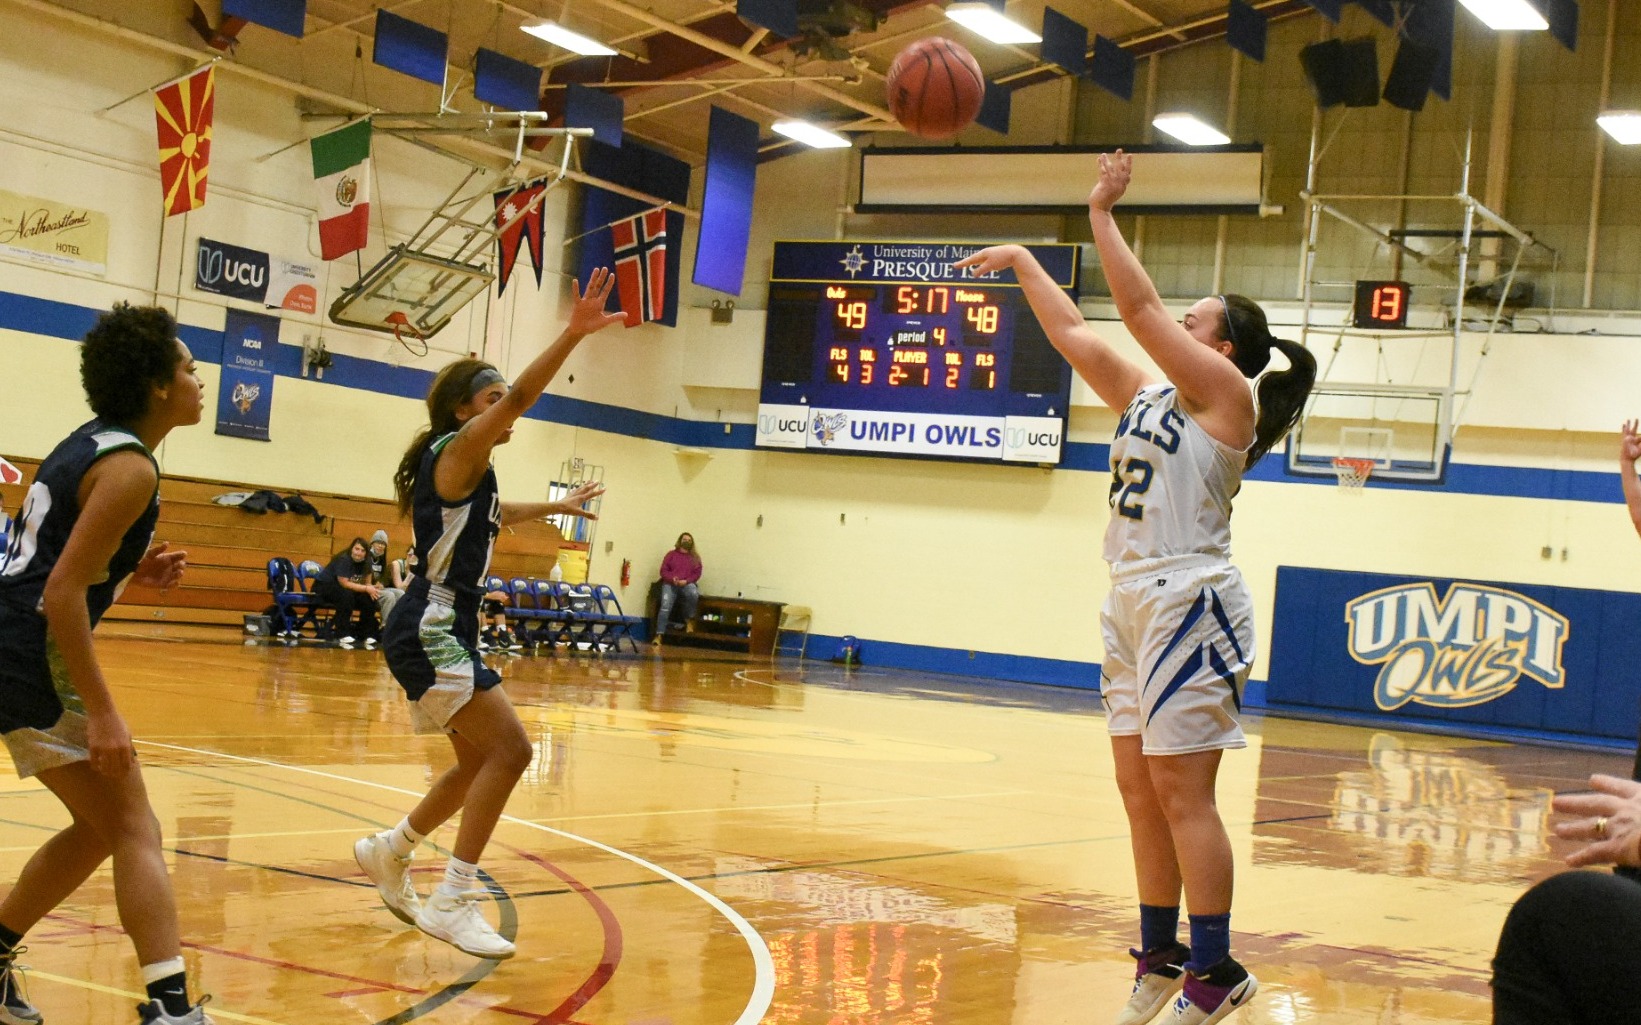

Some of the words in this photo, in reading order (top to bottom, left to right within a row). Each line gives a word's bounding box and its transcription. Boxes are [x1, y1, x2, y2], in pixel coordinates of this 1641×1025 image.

[56, 242, 80, 256] HOTEL
[873, 245, 932, 262] University
[936, 245, 949, 259] of
[951, 246, 982, 260] Mai
[224, 259, 264, 288] UCU
[872, 259, 954, 281] PRESQUE
[898, 287, 948, 313] 5:17
[955, 289, 985, 302] Moose
[1371, 287, 1400, 320] 13
[837, 303, 866, 328] 49
[967, 306, 998, 333] 48
[898, 330, 926, 344] period
[933, 328, 945, 345] 4
[830, 348, 847, 360] FLS
[860, 349, 875, 361] TOL
[893, 350, 928, 364] PLAYER
[945, 353, 962, 365] TOL
[975, 354, 994, 366] FLS
[837, 365, 848, 381] 4
[861, 365, 873, 384] 3
[945, 368, 959, 388] 2
[988, 371, 995, 389] 1
[778, 419, 807, 432] UCU
[851, 420, 914, 443] UMPI
[925, 424, 1001, 448] OWLS
[1028, 432, 1059, 447] UCU
[1347, 583, 1568, 686] UMPI
